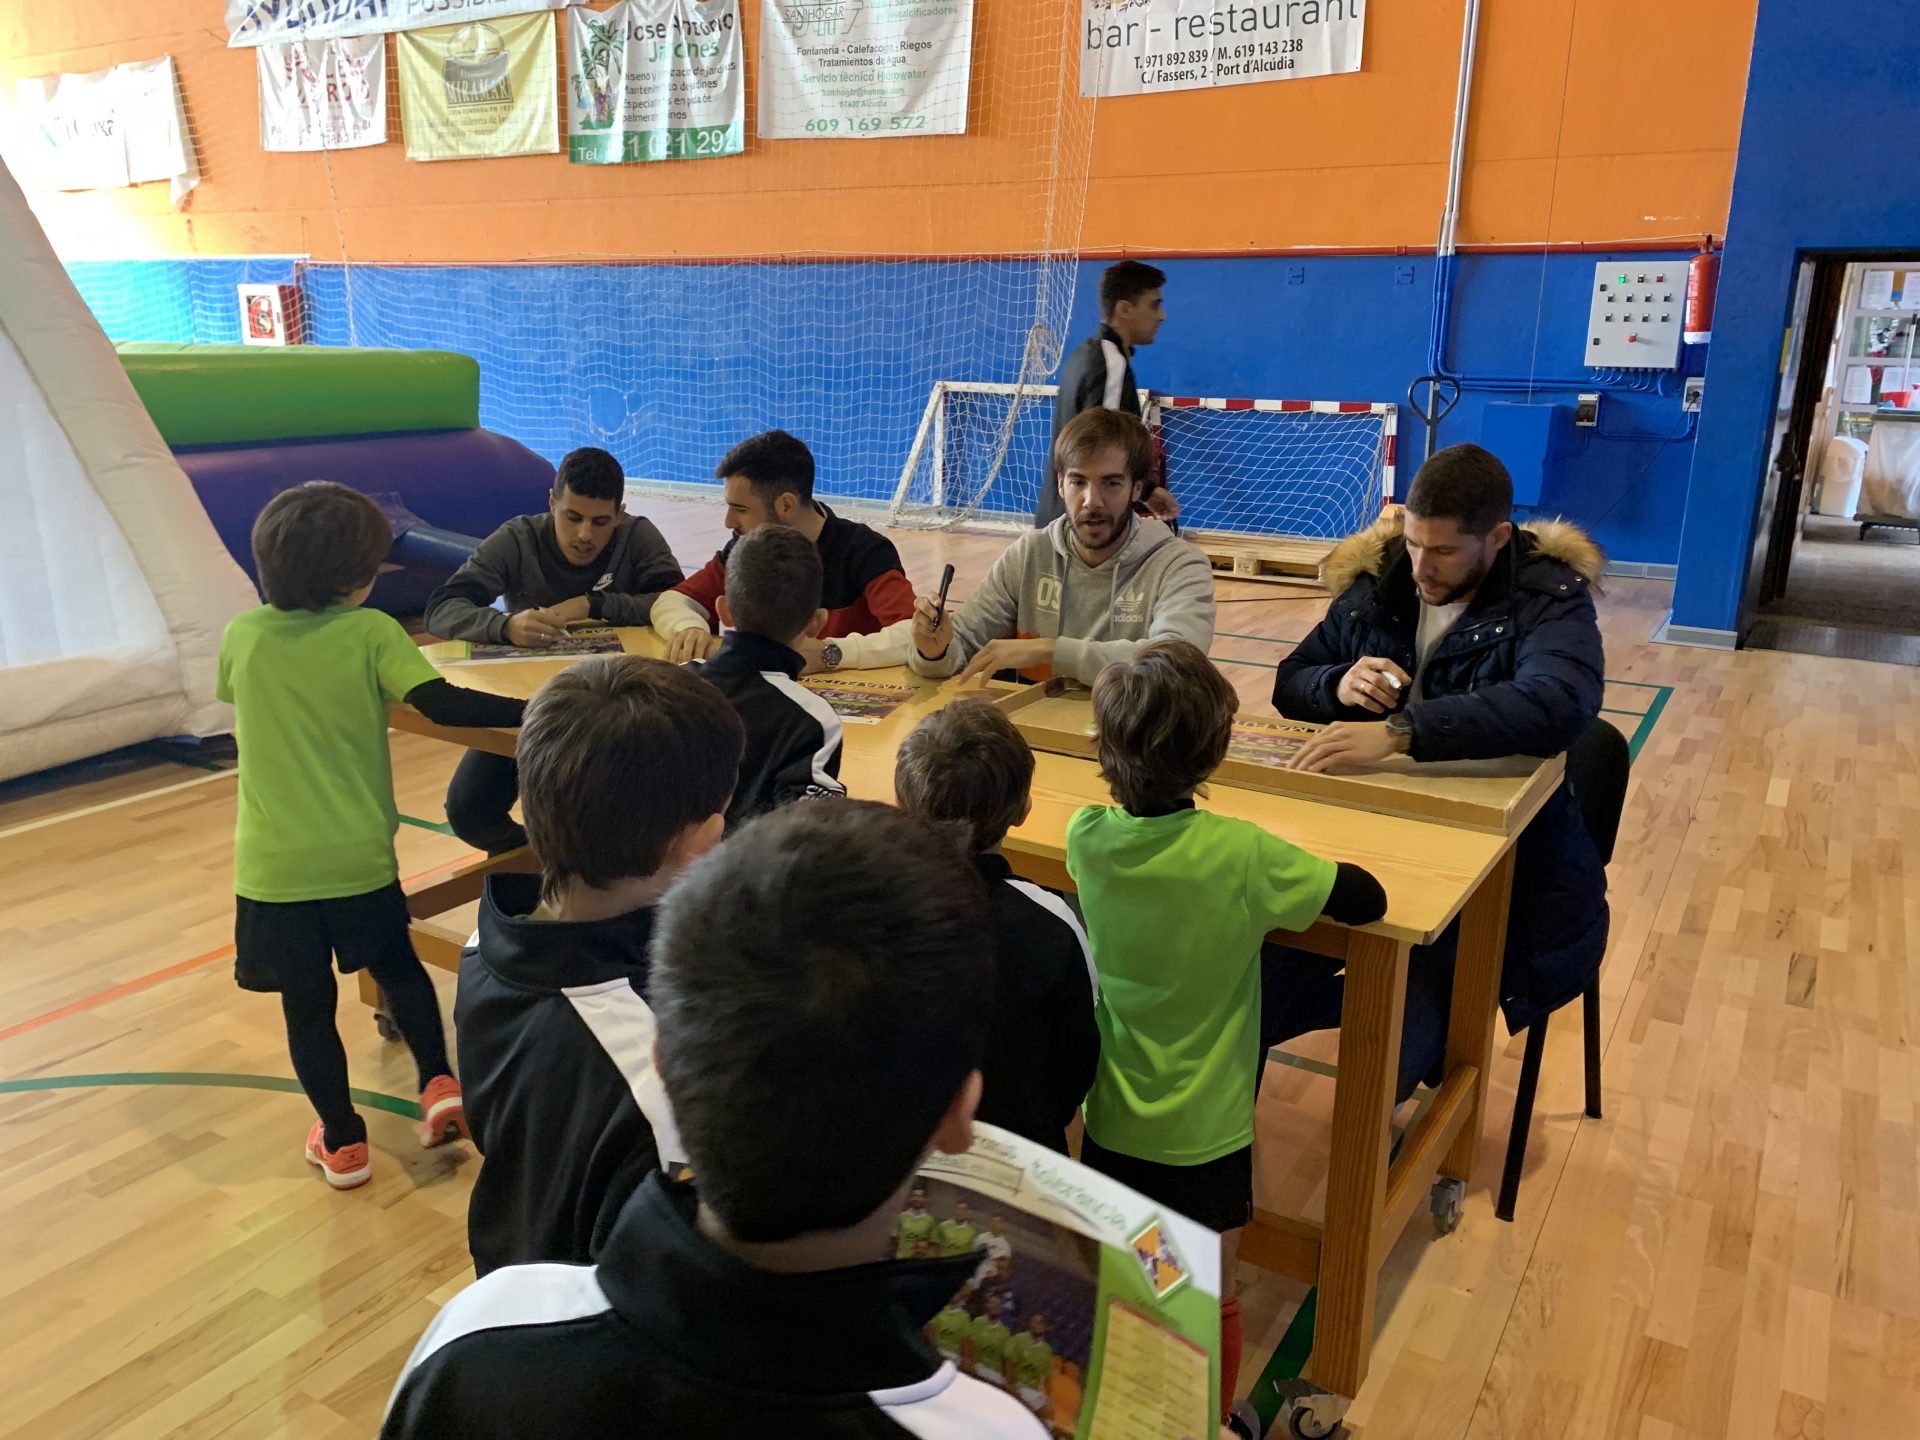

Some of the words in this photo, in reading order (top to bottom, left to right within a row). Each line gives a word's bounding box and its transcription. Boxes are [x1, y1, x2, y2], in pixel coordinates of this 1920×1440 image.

[1087, 19, 1140, 50] bar
[1174, 0, 1358, 40] restaurant
[900, 41, 932, 52] Riegos
[1135, 56, 1143, 69] T.
[1145, 54, 1163, 67] 971
[1166, 52, 1186, 65] 892
[1188, 50, 1208, 63] 839
[1218, 47, 1231, 60] M.
[1234, 45, 1255, 58] 619
[1258, 42, 1278, 56] 143
[1281, 39, 1303, 53] 238
[819, 57, 873, 67] Tratamientos
[803, 73, 837, 83] Servicio
[1157, 67, 1198, 83] Fassers,
[1201, 66, 1207, 78] 2
[1216, 62, 1240, 76] Port
[805, 118, 839, 132] 609
[847, 117, 881, 131] 169
[890, 115, 926, 130] 572
[577, 147, 599, 161] Tel.
